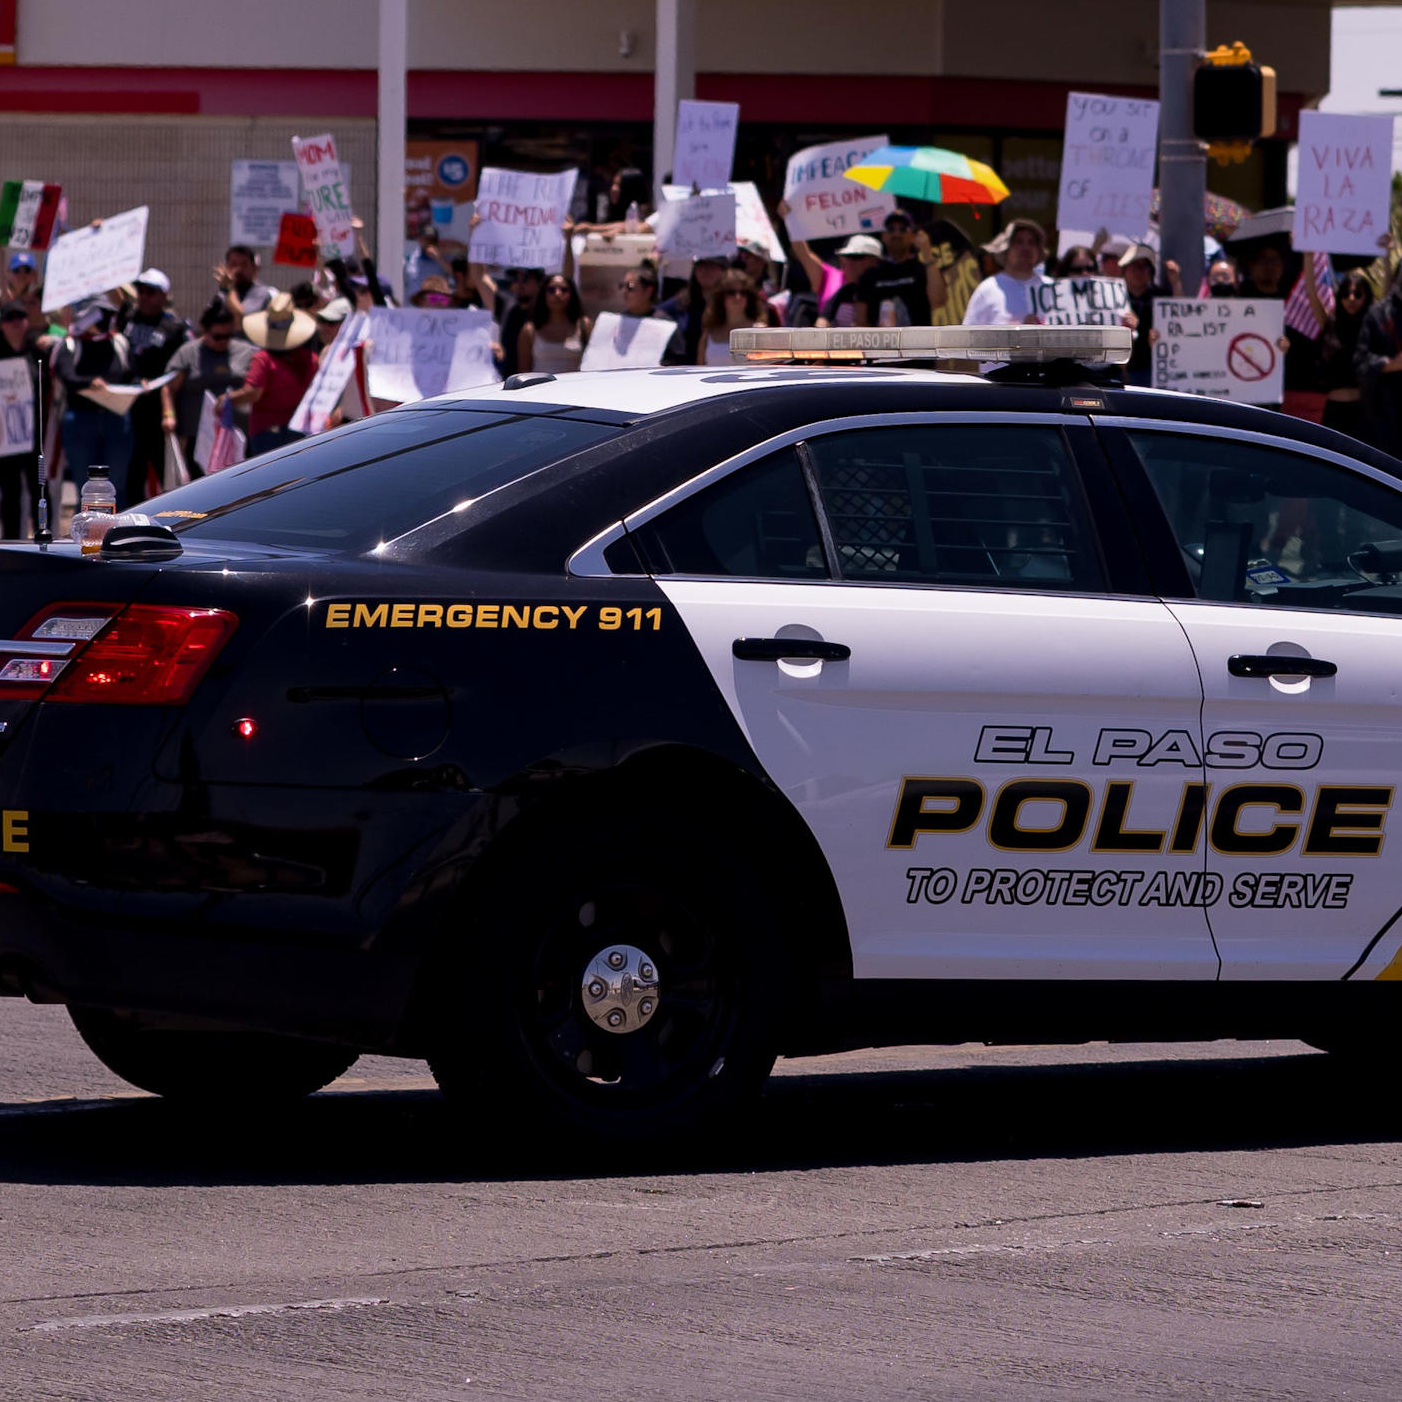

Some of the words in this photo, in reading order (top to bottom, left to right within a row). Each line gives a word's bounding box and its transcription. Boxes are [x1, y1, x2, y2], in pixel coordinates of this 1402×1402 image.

[1070, 144, 1149, 170] THRONE
[1311, 146, 1374, 170] VIVA
[1323, 174, 1354, 198] LA
[805, 189, 867, 211] FELON
[1304, 205, 1374, 239] RAZA
[1029, 281, 1064, 315] ICE
[1159, 301, 1208, 318] TRUMP
[1244, 305, 1255, 317] A
[832, 333, 848, 349] EL
[850, 333, 880, 349] PASO
[883, 333, 899, 349] PD
[325, 603, 588, 629] EMERGENCY
[598, 606, 662, 631] 911
[974, 725, 1075, 765] EL
[1092, 727, 1325, 770] PASO
[885, 774, 1397, 857] POLICE
[906, 868, 958, 904] TO
[962, 868, 1143, 908] PROTECT
[1139, 870, 1224, 909] AND
[1227, 871, 1354, 910] SERVE
